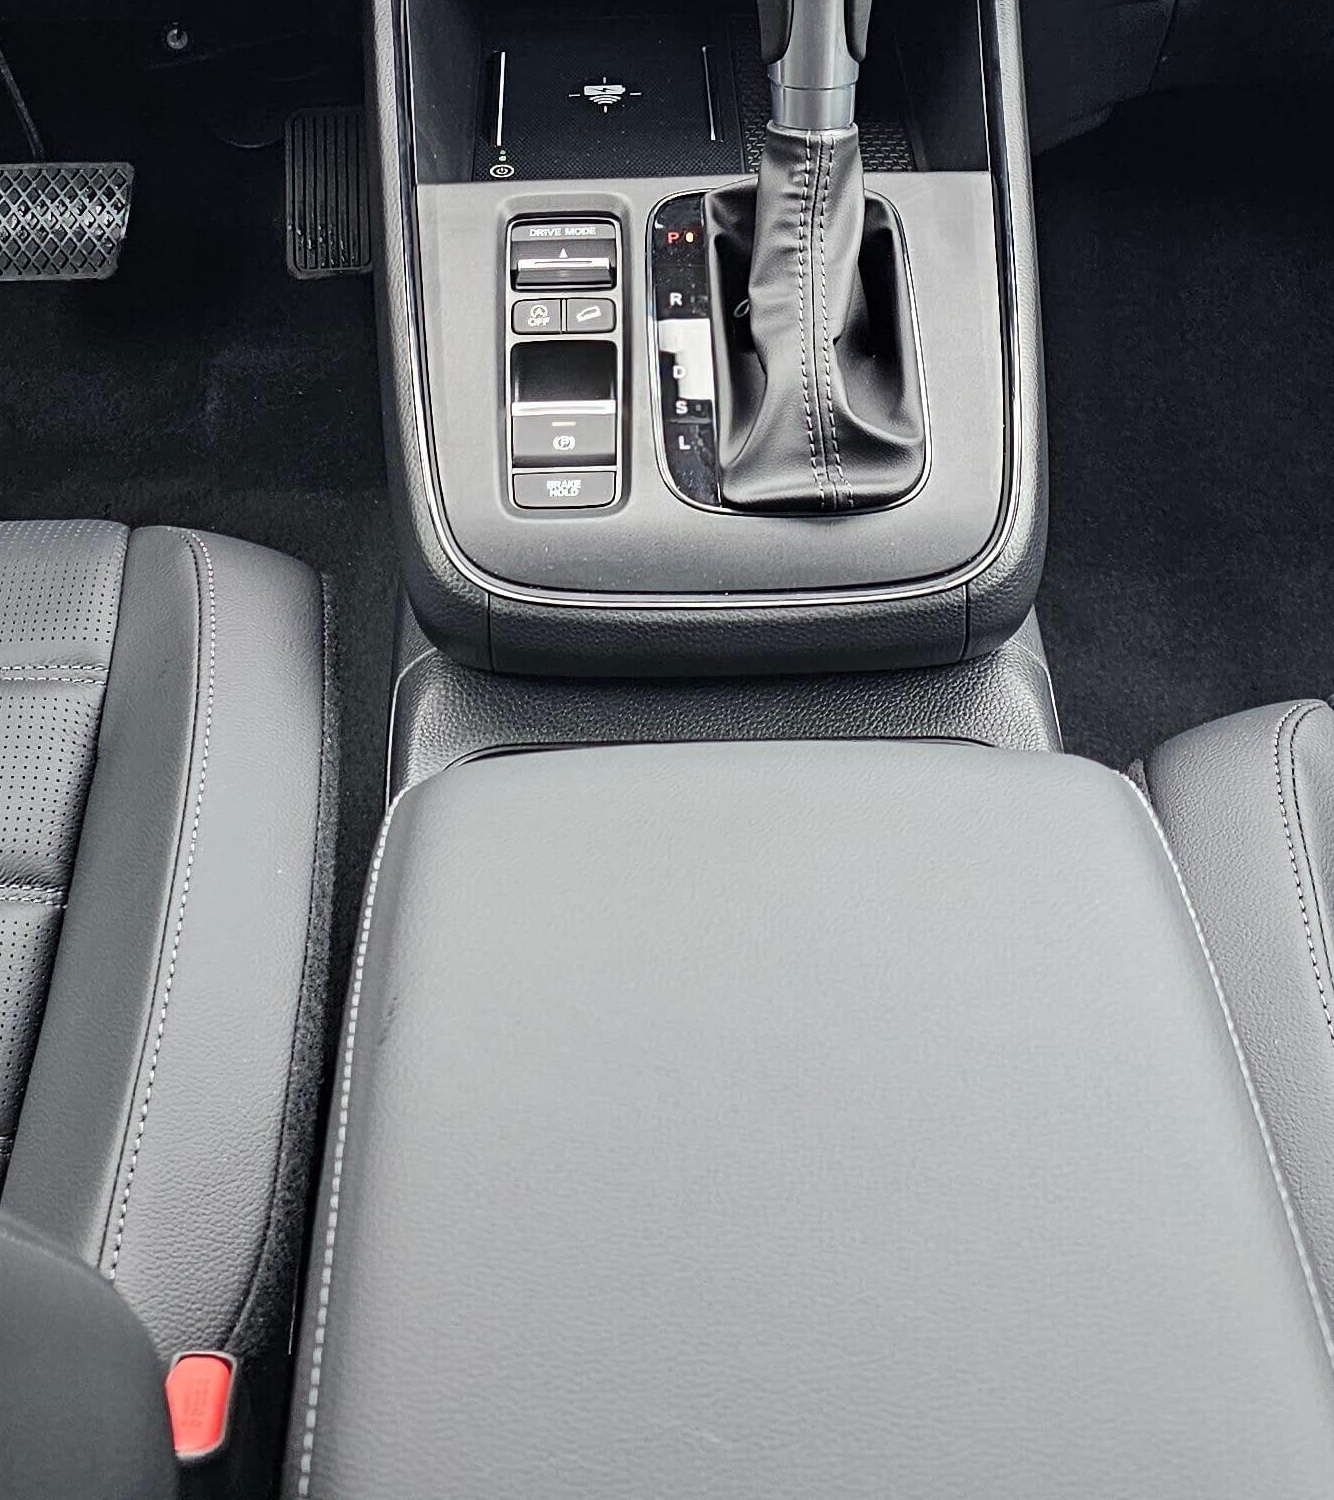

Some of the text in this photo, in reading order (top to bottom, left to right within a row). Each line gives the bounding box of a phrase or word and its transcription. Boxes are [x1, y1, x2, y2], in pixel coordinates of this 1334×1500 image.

[529, 227, 597, 236] DRIVE MODE
[668, 232, 679, 243] P
[670, 292, 682, 306] R
[528, 317, 550, 326] OFF
[673, 366, 686, 378] D
[676, 401, 688, 414] S
[679, 436, 691, 450] L
